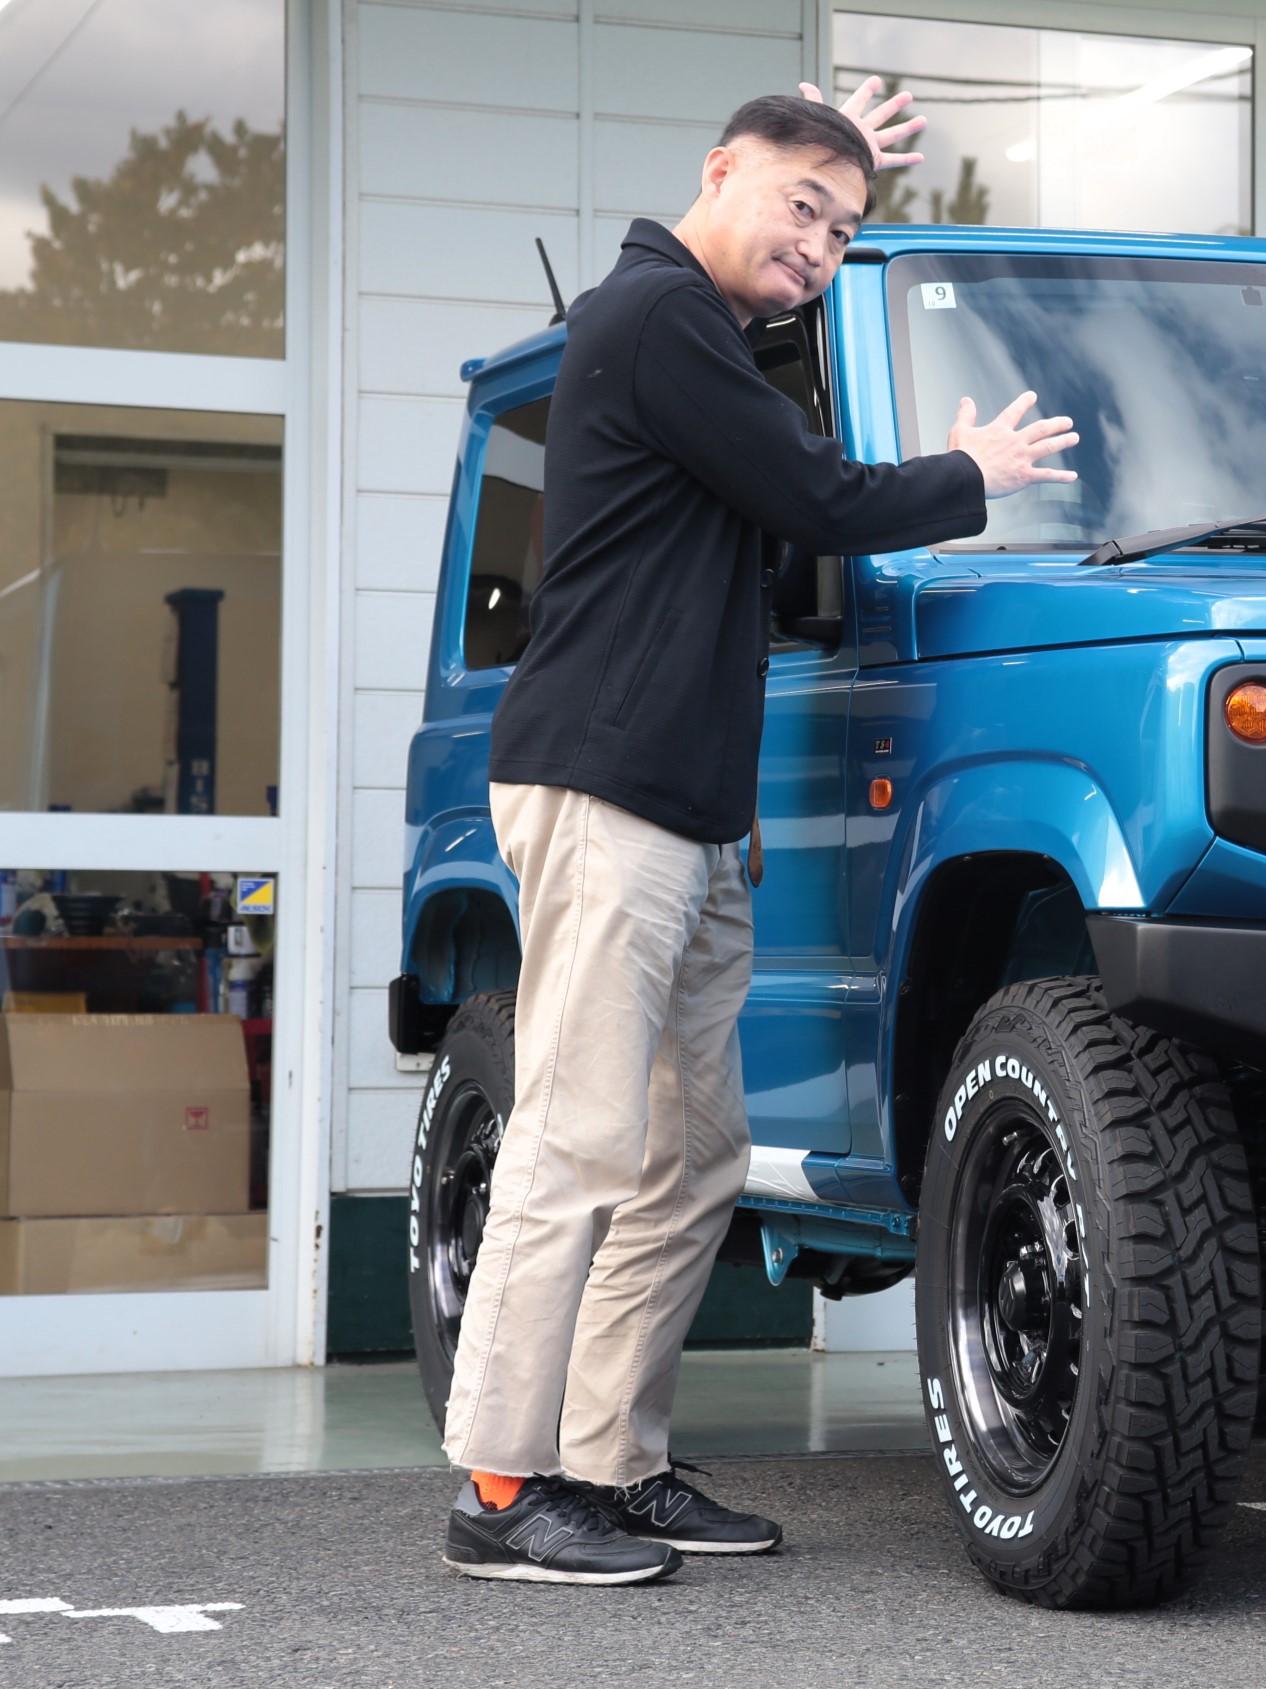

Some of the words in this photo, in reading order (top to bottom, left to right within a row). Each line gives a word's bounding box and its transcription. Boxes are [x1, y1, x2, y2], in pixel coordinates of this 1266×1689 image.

[935, 286, 946, 301] 9
[944, 1059, 992, 1142] OPEN
[994, 1055, 1077, 1181] COUNTRY
[410, 1154, 423, 1273] TOYO
[418, 1055, 451, 1150] TIRES
[927, 1378, 978, 1514] TIRES
[628, 1480, 692, 1527] N
[973, 1505, 1035, 1539] TOYO
[506, 1513, 574, 1562] N
